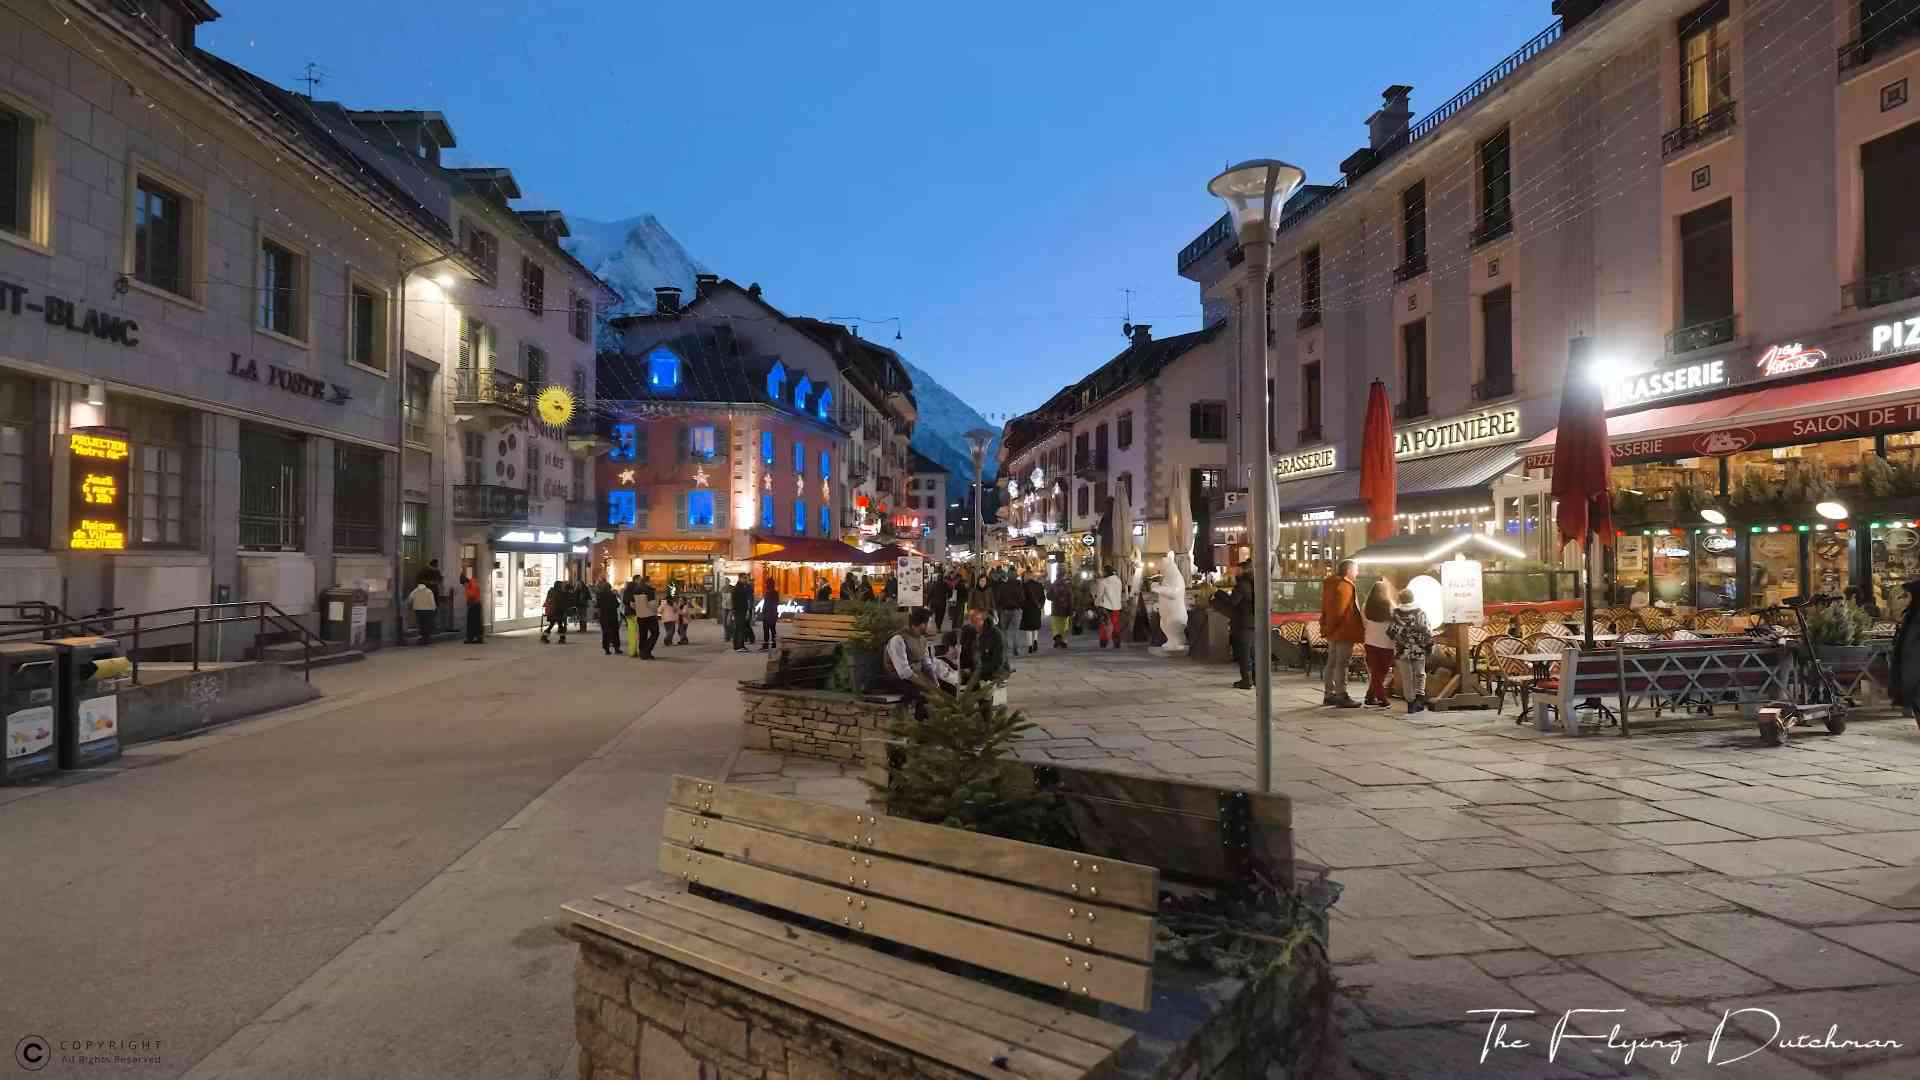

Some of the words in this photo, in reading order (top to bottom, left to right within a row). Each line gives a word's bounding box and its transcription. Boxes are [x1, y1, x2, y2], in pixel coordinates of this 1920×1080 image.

[0, 280, 139, 346] T-BLANC
[227, 352, 259, 381] LA
[267, 364, 325, 399] POSTE
[1612, 360, 1724, 403] RASSERIE
[1414, 411, 1515, 450] POTINIÈRE
[1793, 412, 1859, 436] SALON
[1869, 407, 1895, 426] DE
[1277, 451, 1333, 475] BRASSERIE
[1527, 454, 1554, 470] PIZZ
[1608, 440, 1663, 459] ASSERIE
